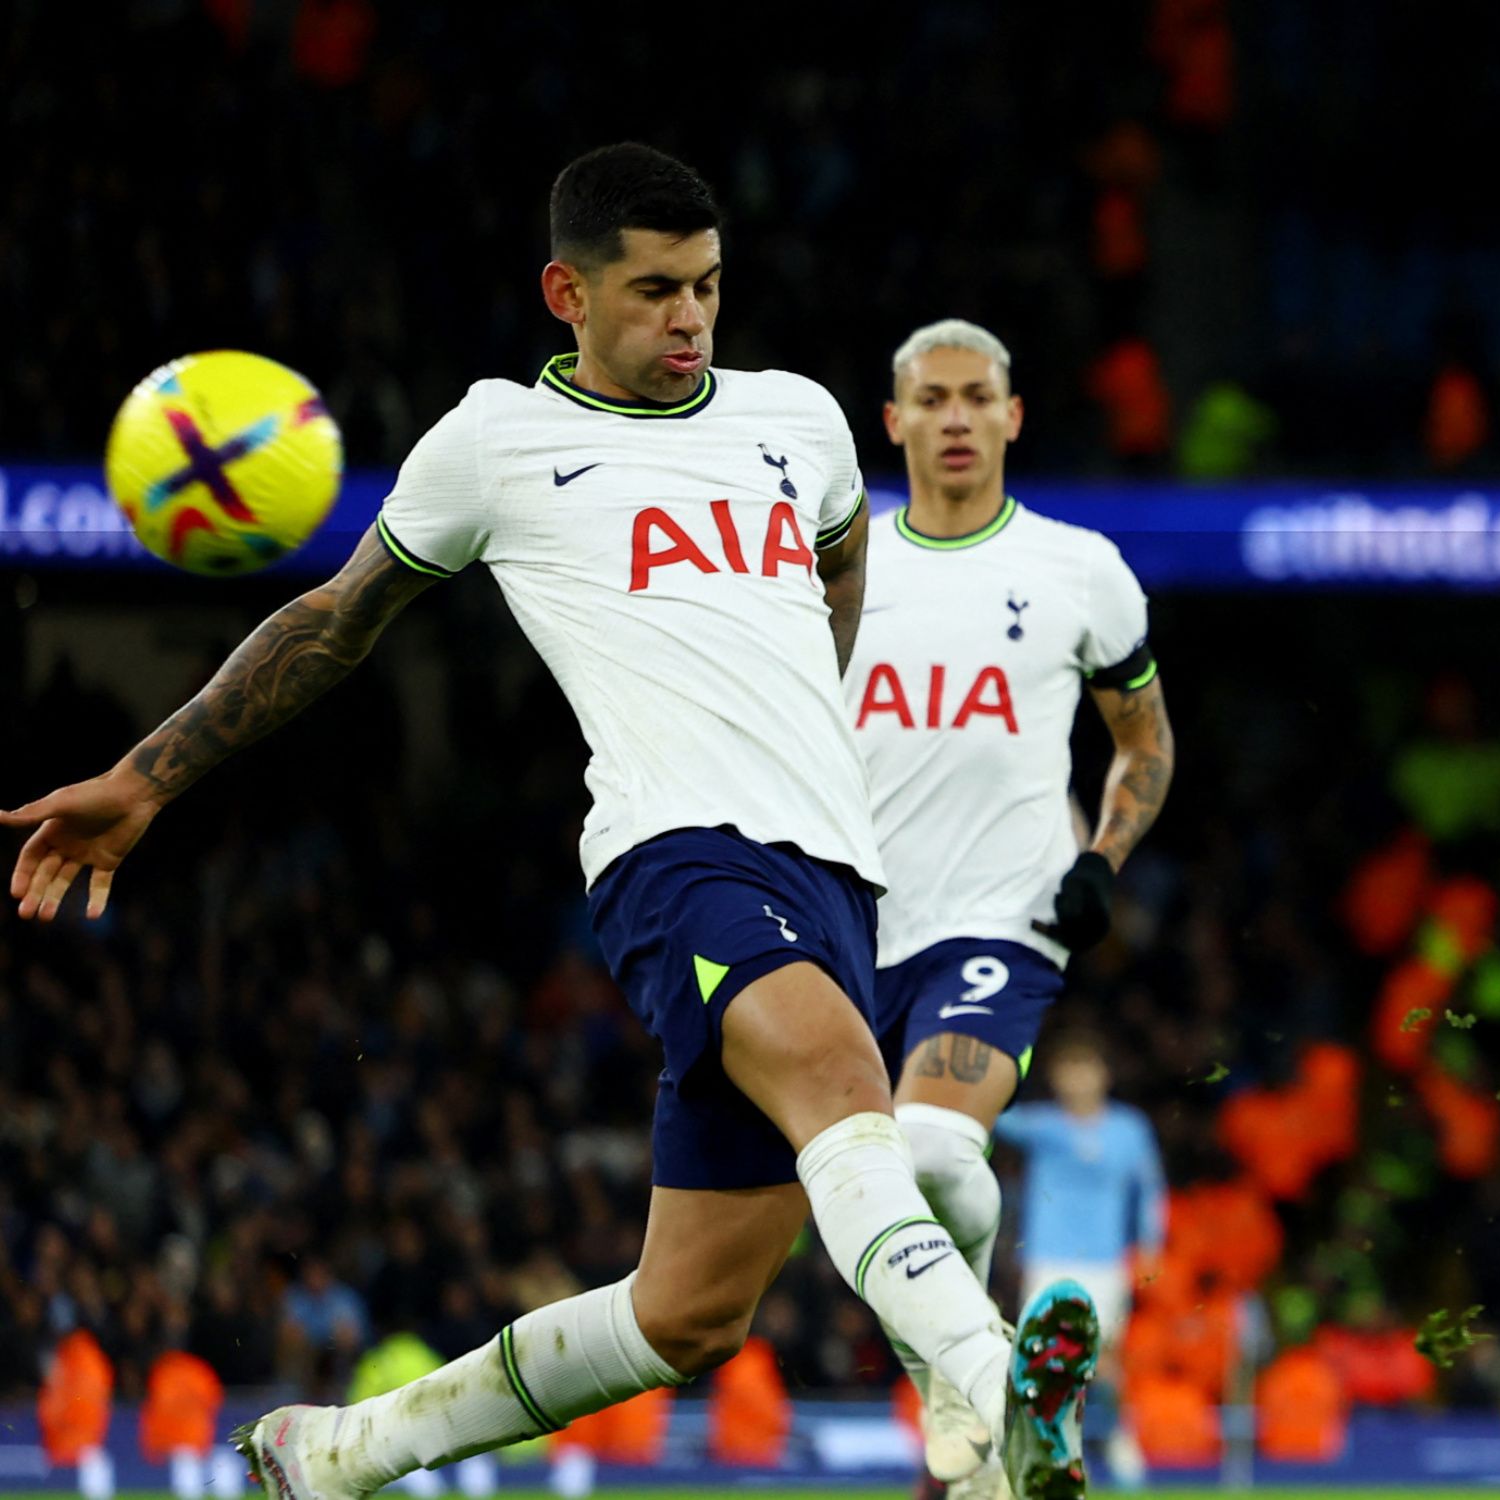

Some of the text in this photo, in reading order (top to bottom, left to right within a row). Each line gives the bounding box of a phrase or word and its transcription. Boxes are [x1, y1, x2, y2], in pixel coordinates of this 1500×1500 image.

[628, 499, 819, 592] AIA
[855, 662, 1020, 735] AIA
[960, 955, 1010, 1003] 9
